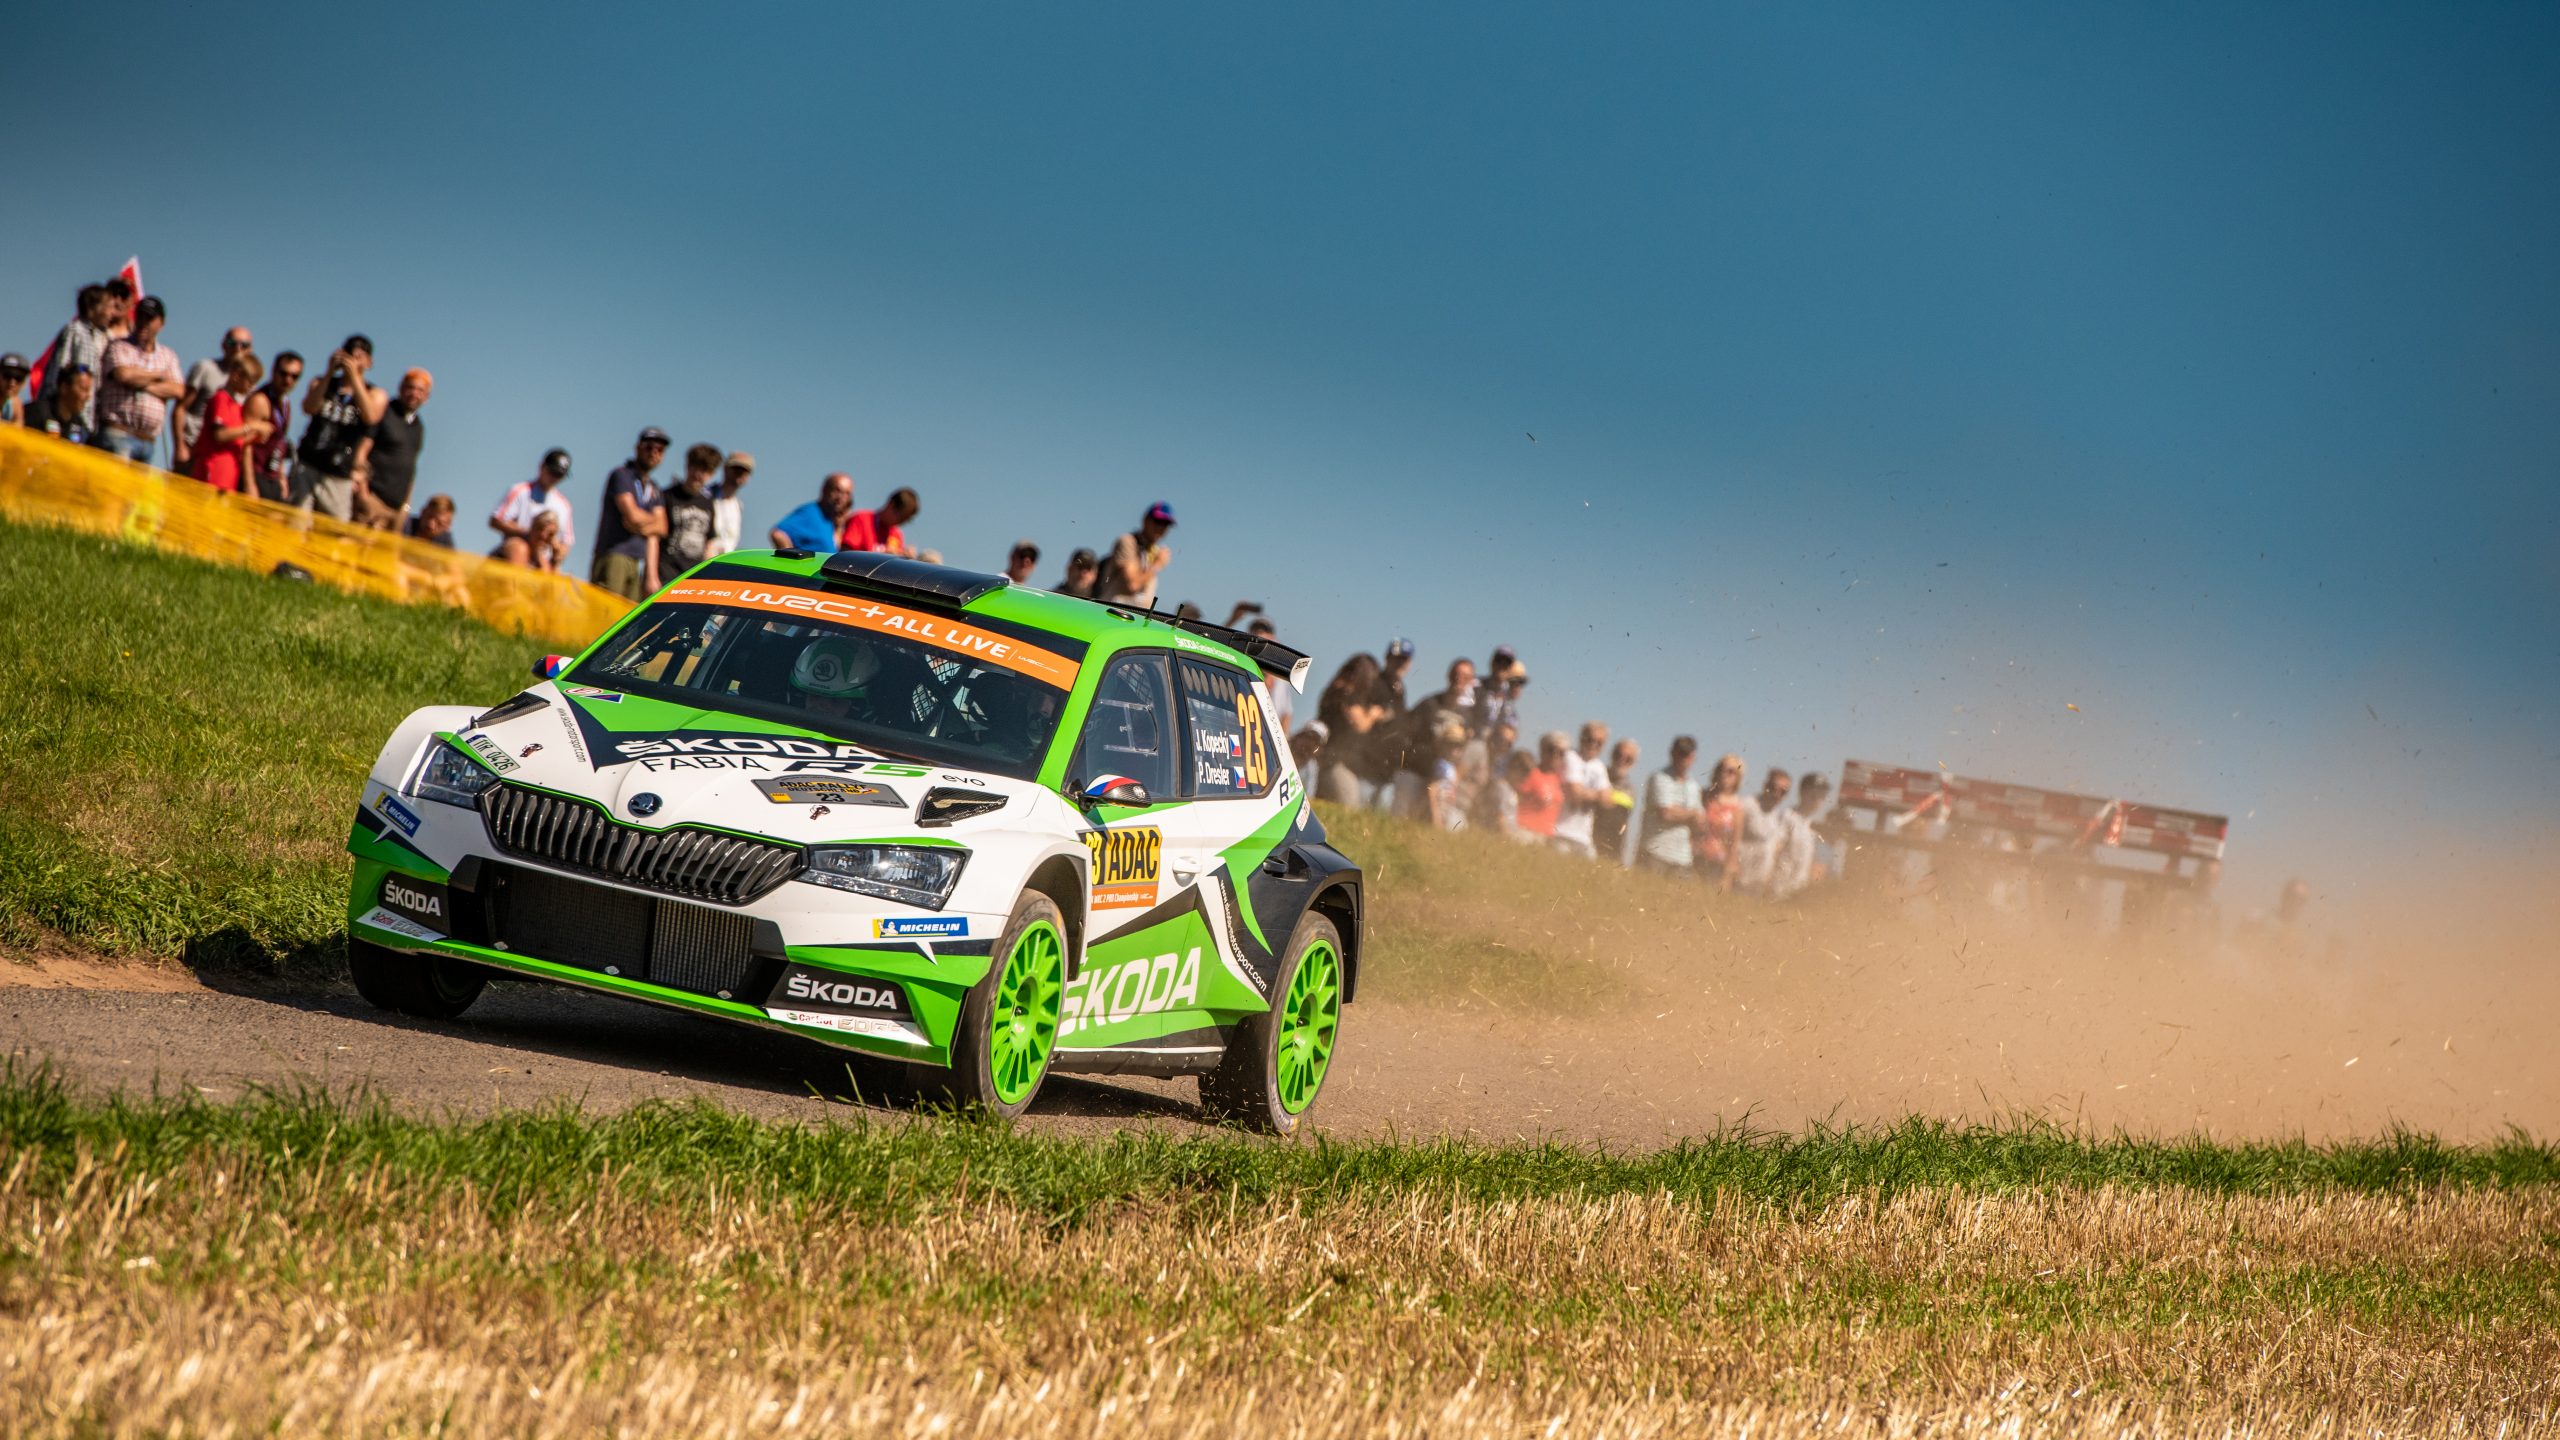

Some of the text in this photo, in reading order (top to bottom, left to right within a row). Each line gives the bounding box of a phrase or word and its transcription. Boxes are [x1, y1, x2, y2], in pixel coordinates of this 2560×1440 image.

[882, 615, 937, 638] ALL
[945, 629, 1011, 658] LIVE
[615, 738, 890, 760] ŠKODA
[1195, 729, 1230, 760] J. Kopecký
[1236, 693, 1268, 788] 23
[486, 751, 514, 771] 0426
[639, 756, 986, 787] FABIA R5 evo
[1198, 761, 1230, 785] P. Dresler
[816, 793, 846, 803] 23
[1279, 771, 1297, 807] R5
[388, 806, 416, 830] MICHELIN
[1108, 829, 1160, 881] ADAC
[385, 880, 442, 917] ŠKODA
[899, 923, 961, 933] MICHELIN
[787, 973, 897, 1010] ŠKODA
